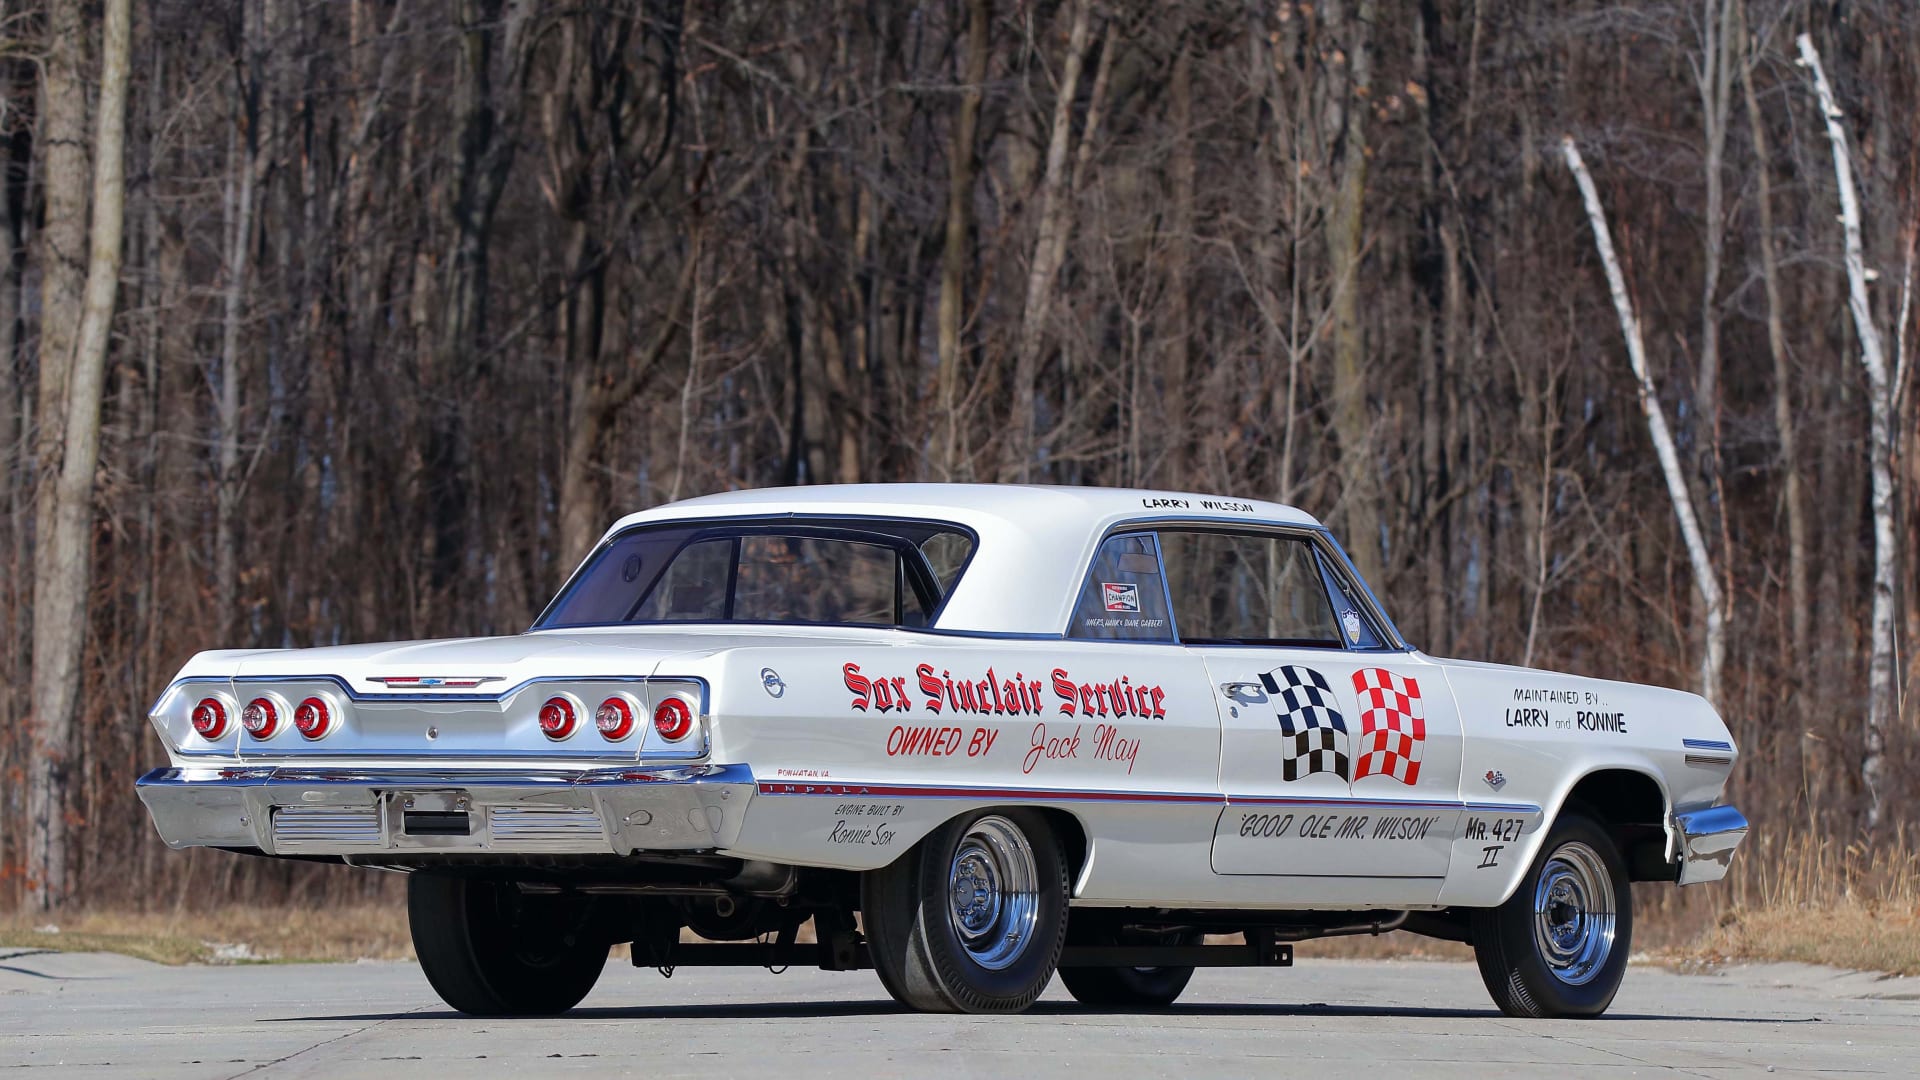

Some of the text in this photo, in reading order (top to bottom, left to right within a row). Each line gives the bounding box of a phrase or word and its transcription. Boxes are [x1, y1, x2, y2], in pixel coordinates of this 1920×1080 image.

[1142, 498, 1254, 513] LARRY WILSON
[1108, 593, 1135, 604] CHAMPION
[843, 662, 1167, 720] Sox Sinclair Service
[1513, 688, 1579, 704] MAINTAINED
[1505, 708, 1627, 733] LARRY and RONNIE
[886, 723, 1141, 775] OWNED BY Jack May
[769, 784, 869, 794] IMPALA
[834, 804, 904, 816] ENGINE BUILT BY
[827, 819, 896, 845] Ronnie Sox
[1299, 814, 1338, 838] OLE
[1334, 815, 1369, 839] MR.
[1492, 818, 1524, 842] 427
[1476, 845, 1504, 869] II
